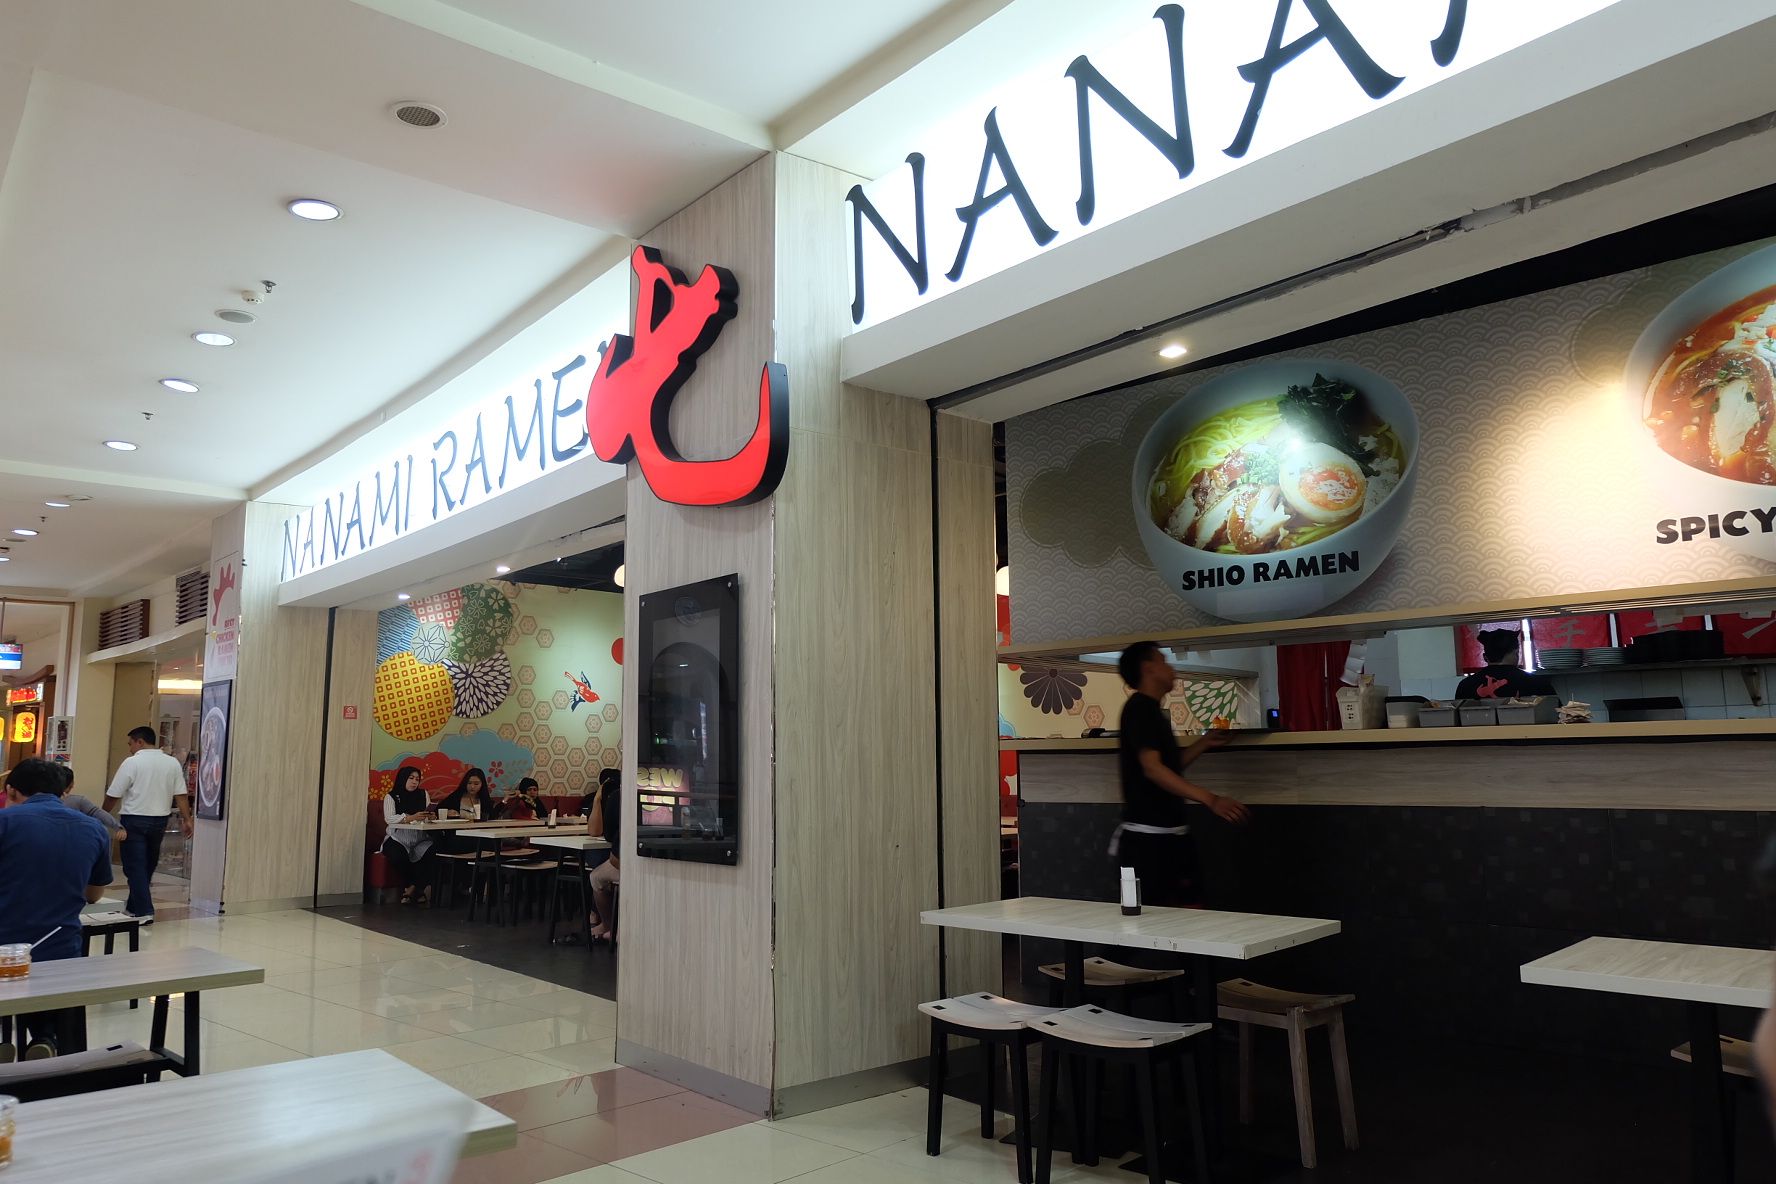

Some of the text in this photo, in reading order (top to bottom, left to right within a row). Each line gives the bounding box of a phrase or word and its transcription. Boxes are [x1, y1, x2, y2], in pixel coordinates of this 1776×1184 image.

[845, 0, 1468, 325] NANA
[280, 341, 608, 582] NANAMI RAME
[1656, 506, 1776, 544] SPICY
[1182, 551, 1360, 591] SHIO RAMEN
